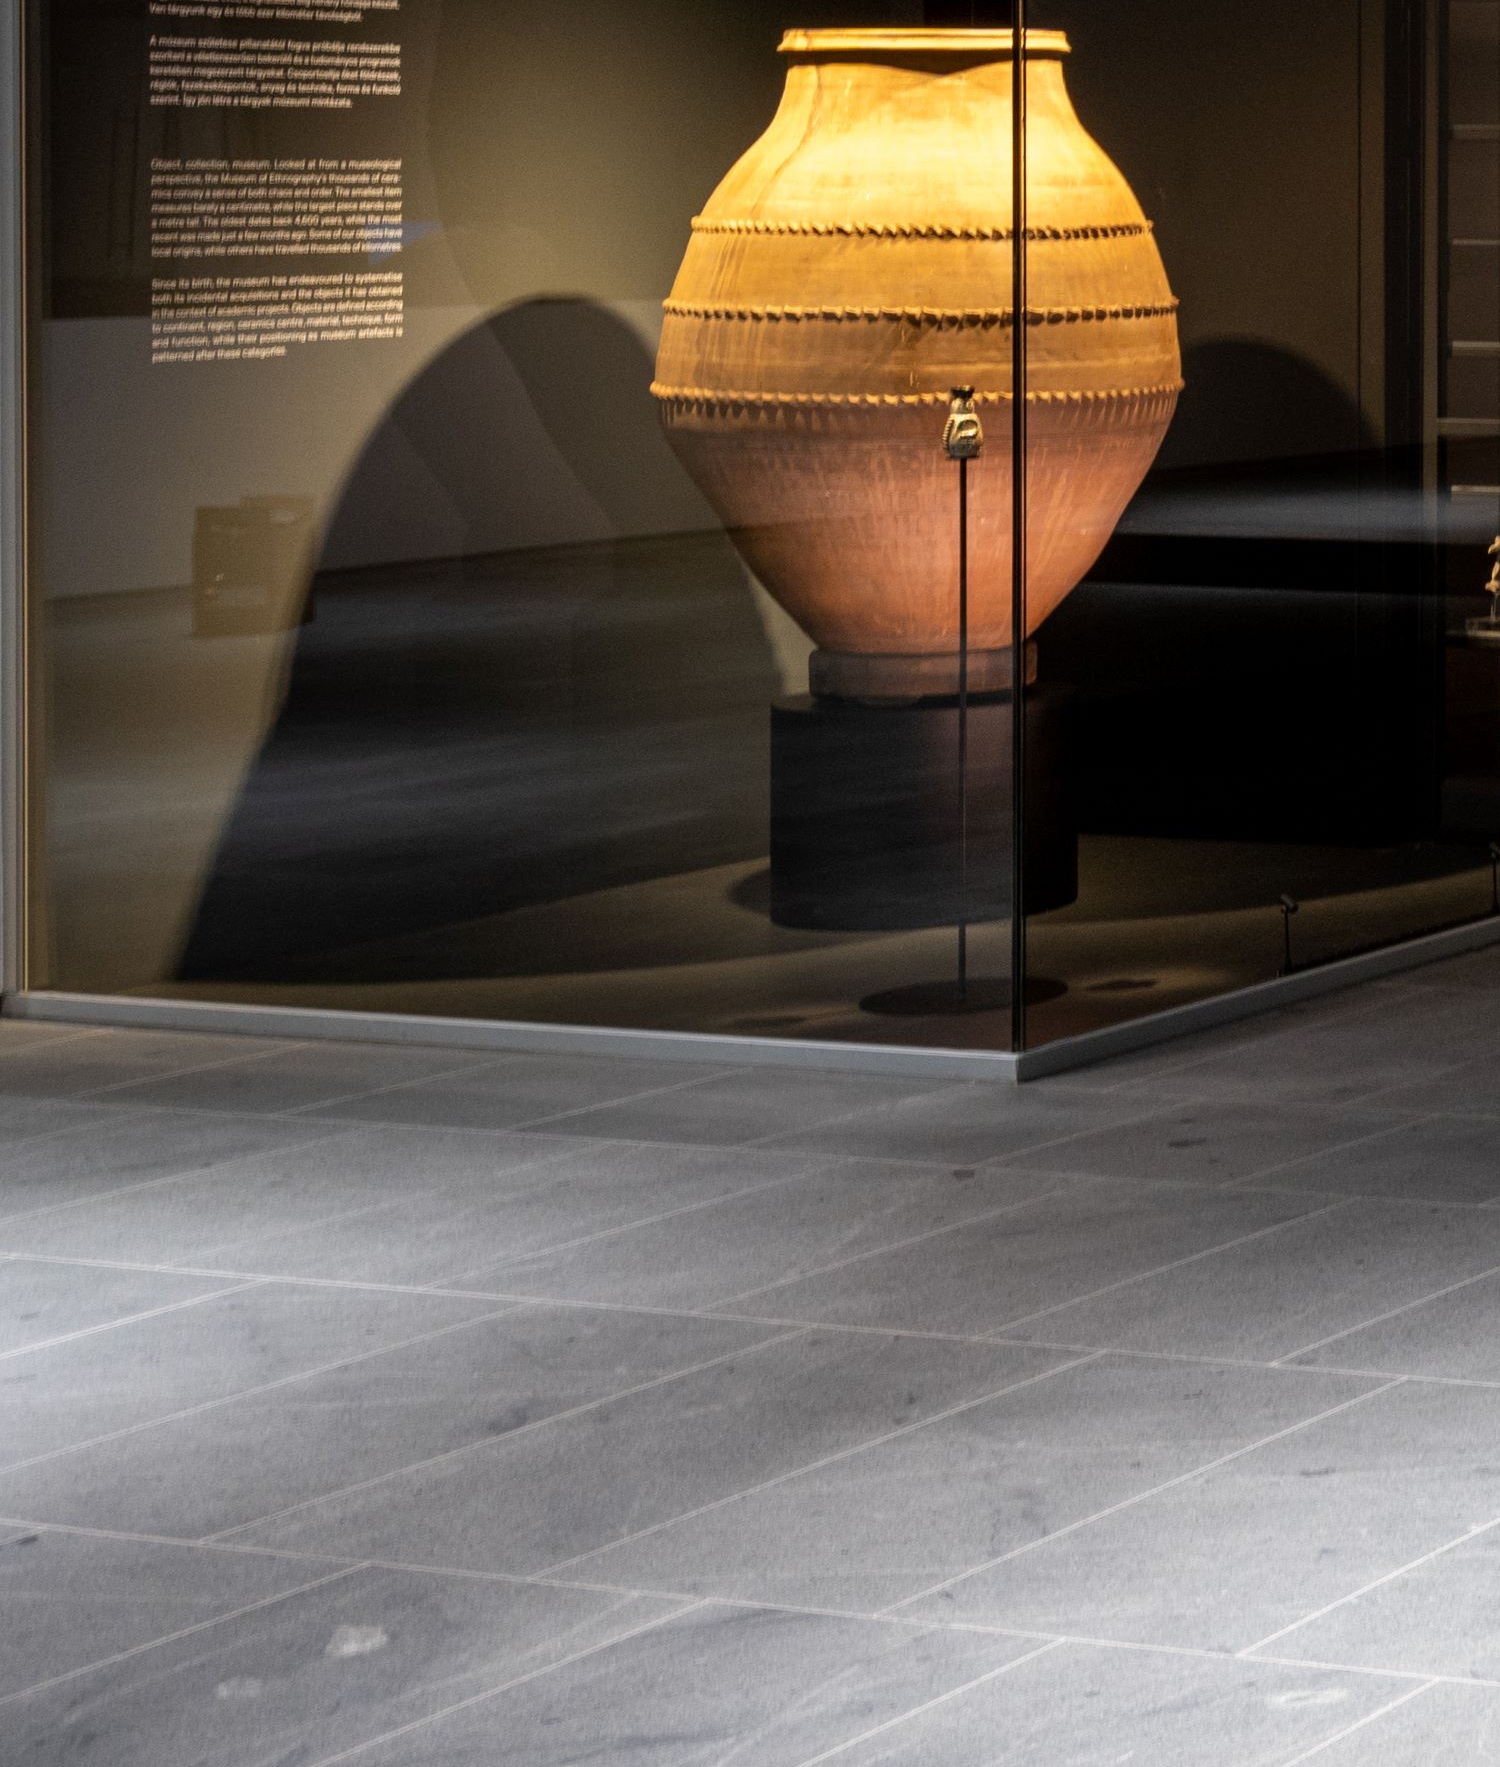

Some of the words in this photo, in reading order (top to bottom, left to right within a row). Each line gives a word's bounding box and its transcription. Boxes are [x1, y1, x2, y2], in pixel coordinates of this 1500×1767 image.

[151, 159, 184, 171] Object,
[232, 161, 272, 169] museum.
[274, 158, 306, 169] Looked
[318, 158, 339, 169] from
[205, 174, 219, 185] the
[220, 173, 257, 184] Museum
[248, 187, 267, 198] both
[294, 187, 310, 198] and
[336, 187, 350, 198] The
[273, 201, 293, 212] while
[295, 201, 308, 212] the
[203, 216, 219, 227] The
[346, 214, 366, 225] while
[205, 245, 226, 256] while
[152, 278, 177, 289] Since
[216, 276, 231, 287] the
[232, 278, 270, 287] museum
[272, 275, 287, 286] has
[152, 292, 172, 303] both
[281, 289, 296, 300] and
[298, 288, 312, 299] the
[353, 287, 367, 298] has
[161, 307, 175, 318] the
[292, 302, 322, 315] Objects
[152, 336, 169, 348] and
[212, 334, 235, 345] while
[320, 331, 356, 341] museum
[217, 348, 241, 359] these
